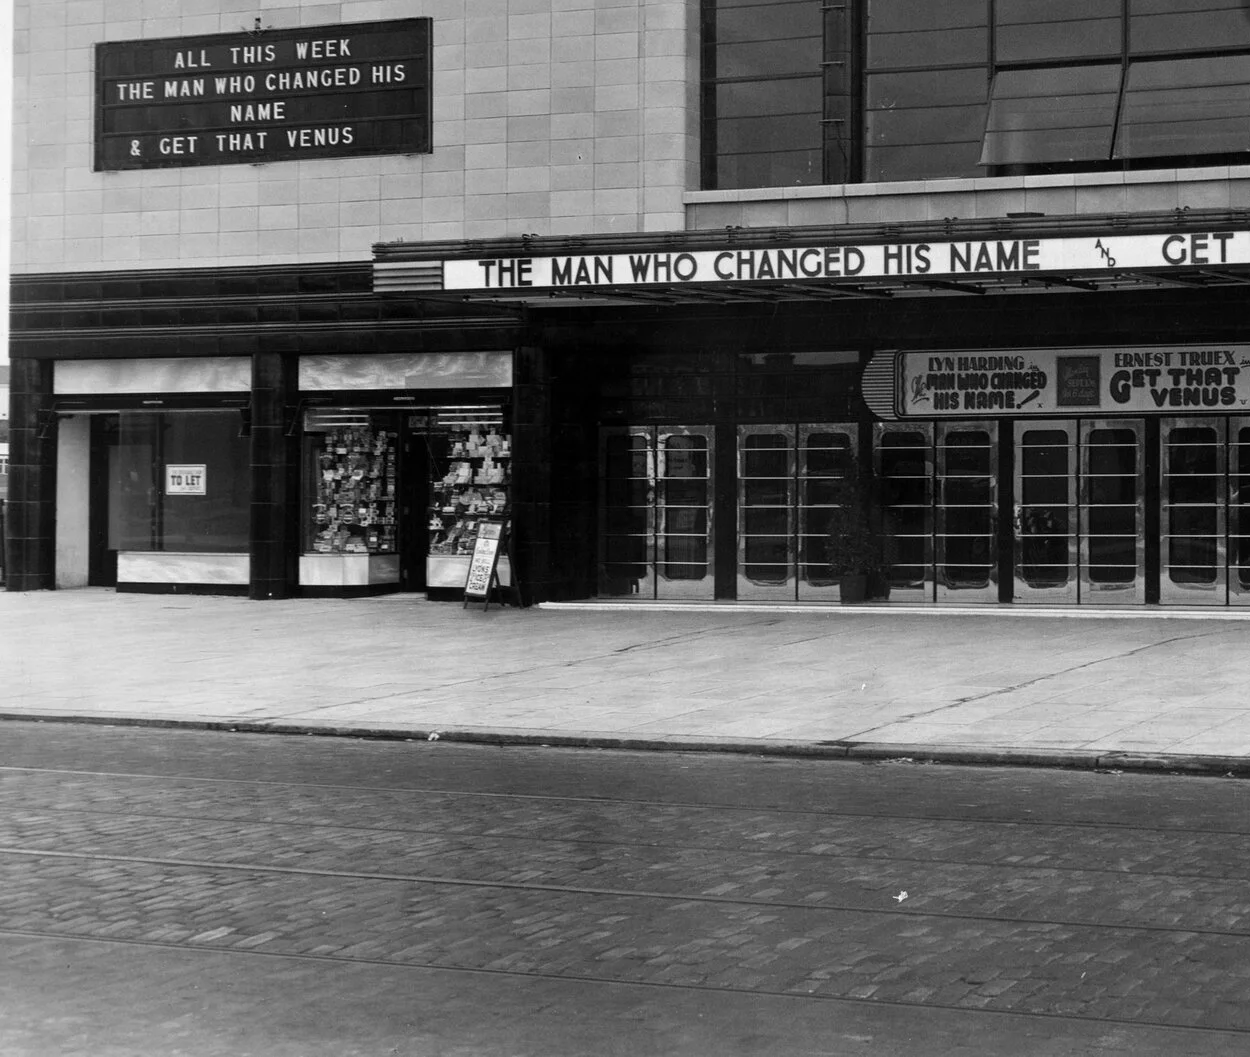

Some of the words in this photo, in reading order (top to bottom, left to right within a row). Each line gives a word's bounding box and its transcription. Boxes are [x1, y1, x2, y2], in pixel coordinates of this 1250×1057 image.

[174, 50, 211, 69] ALL
[230, 45, 276, 64] THIS
[296, 39, 351, 60] WEEK
[117, 82, 154, 100] THE
[164, 79, 204, 98] MAN
[215, 75, 255, 95] WHO
[265, 67, 360, 91] CHANGED
[371, 64, 406, 83] HIS
[230, 103, 286, 122] NAME
[130, 139, 141, 156] &
[159, 136, 198, 155] GET
[216, 132, 268, 152] THAT
[287, 127, 354, 147] VENUS
[478, 258, 533, 288] THE
[552, 255, 612, 285] MAN
[629, 252, 698, 282] WHO
[713, 245, 865, 280] CHANGED
[883, 244, 932, 274] HIS
[950, 240, 1039, 272] NAME
[1093, 238, 1117, 267] AND
[1162, 232, 1235, 266] GET
[928, 358, 956, 371] LYN
[957, 355, 1024, 371] HARDING
[1114, 352, 1172, 368] ERNEST
[1178, 351, 1236, 366] TRUEX
[927, 373, 956, 390] MAN
[957, 372, 989, 390] WHO
[989, 371, 1047, 389] CHANGED
[1109, 368, 1164, 404] GET
[1168, 367, 1240, 386] THAT
[933, 391, 959, 410] HIS
[1151, 387, 1236, 407] VENUS
[171, 475, 182, 485] TO
[186, 475, 201, 485] LET
